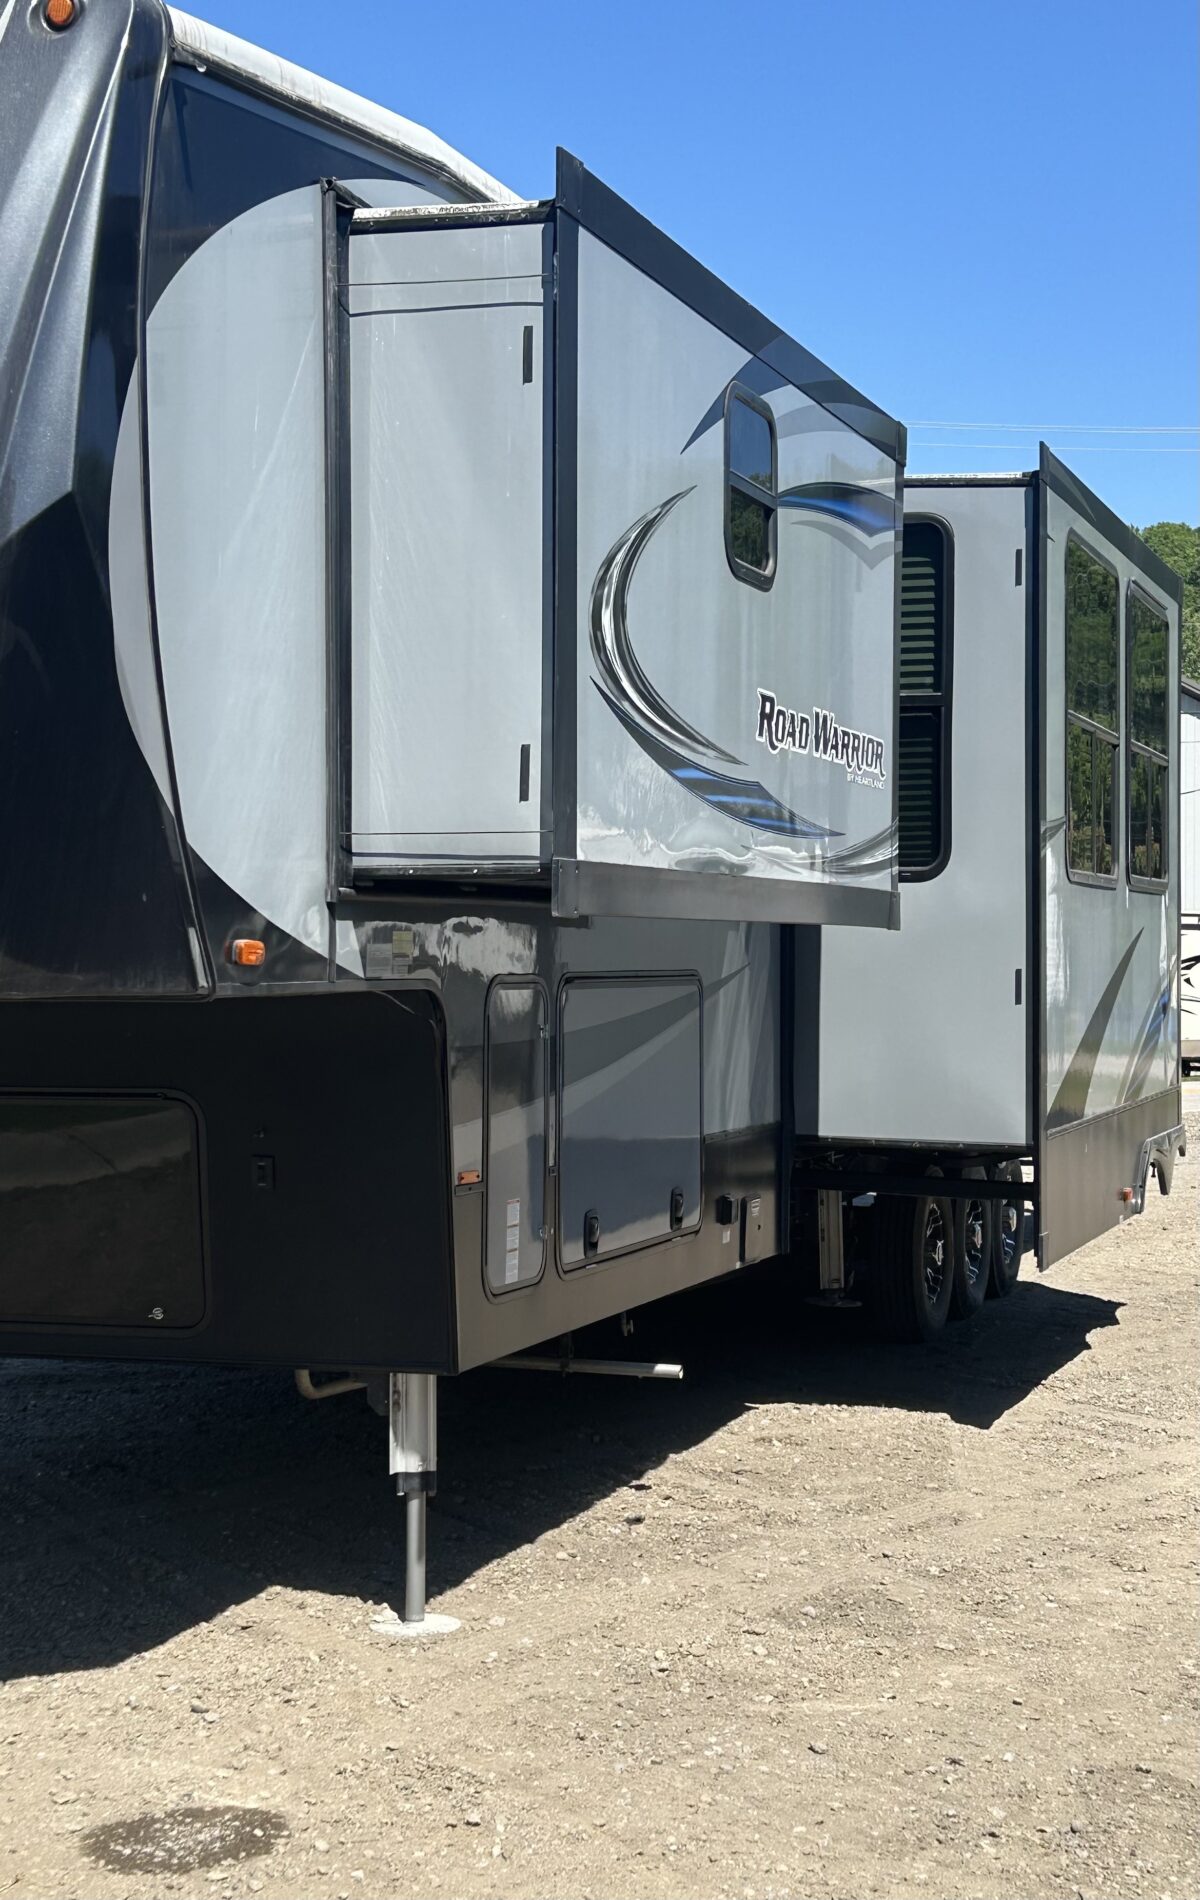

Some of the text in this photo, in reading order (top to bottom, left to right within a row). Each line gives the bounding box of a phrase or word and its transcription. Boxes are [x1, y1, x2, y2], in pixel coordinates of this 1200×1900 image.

[757, 688, 886, 780] ROAD WARRIOR
[855, 775, 885, 789] HEARTLAND
